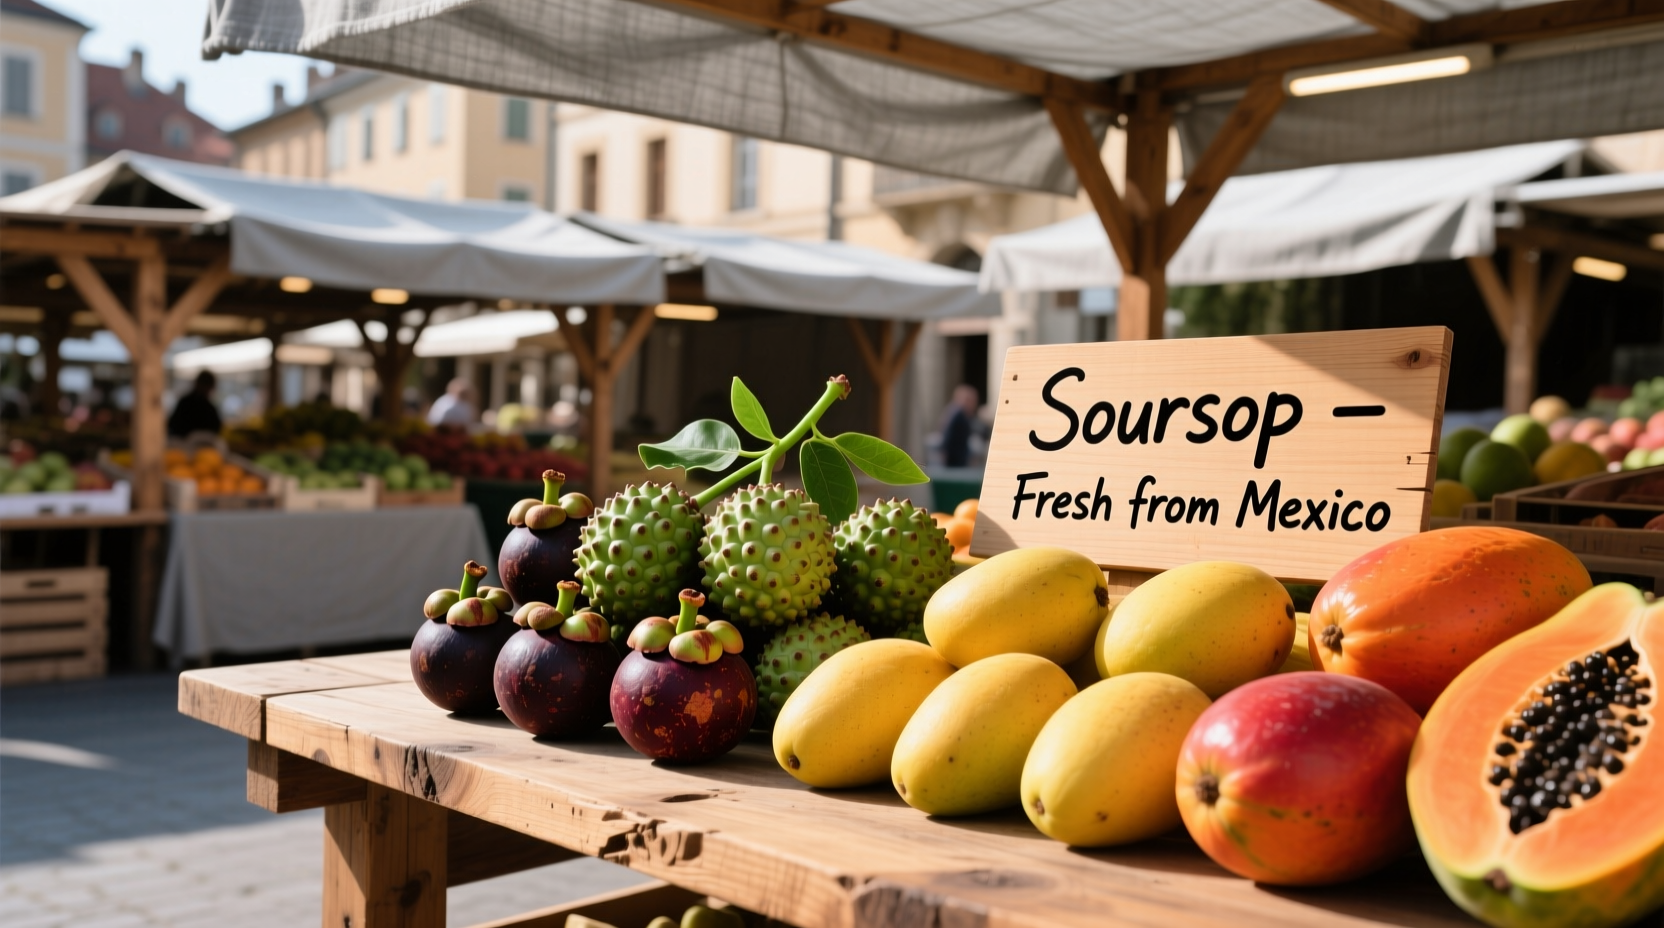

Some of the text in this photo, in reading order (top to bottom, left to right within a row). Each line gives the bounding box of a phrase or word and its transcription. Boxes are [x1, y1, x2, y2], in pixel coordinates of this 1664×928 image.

[1028, 366, 1303, 470] Soursop
[1012, 471, 1391, 532] Fresh from Mexico
